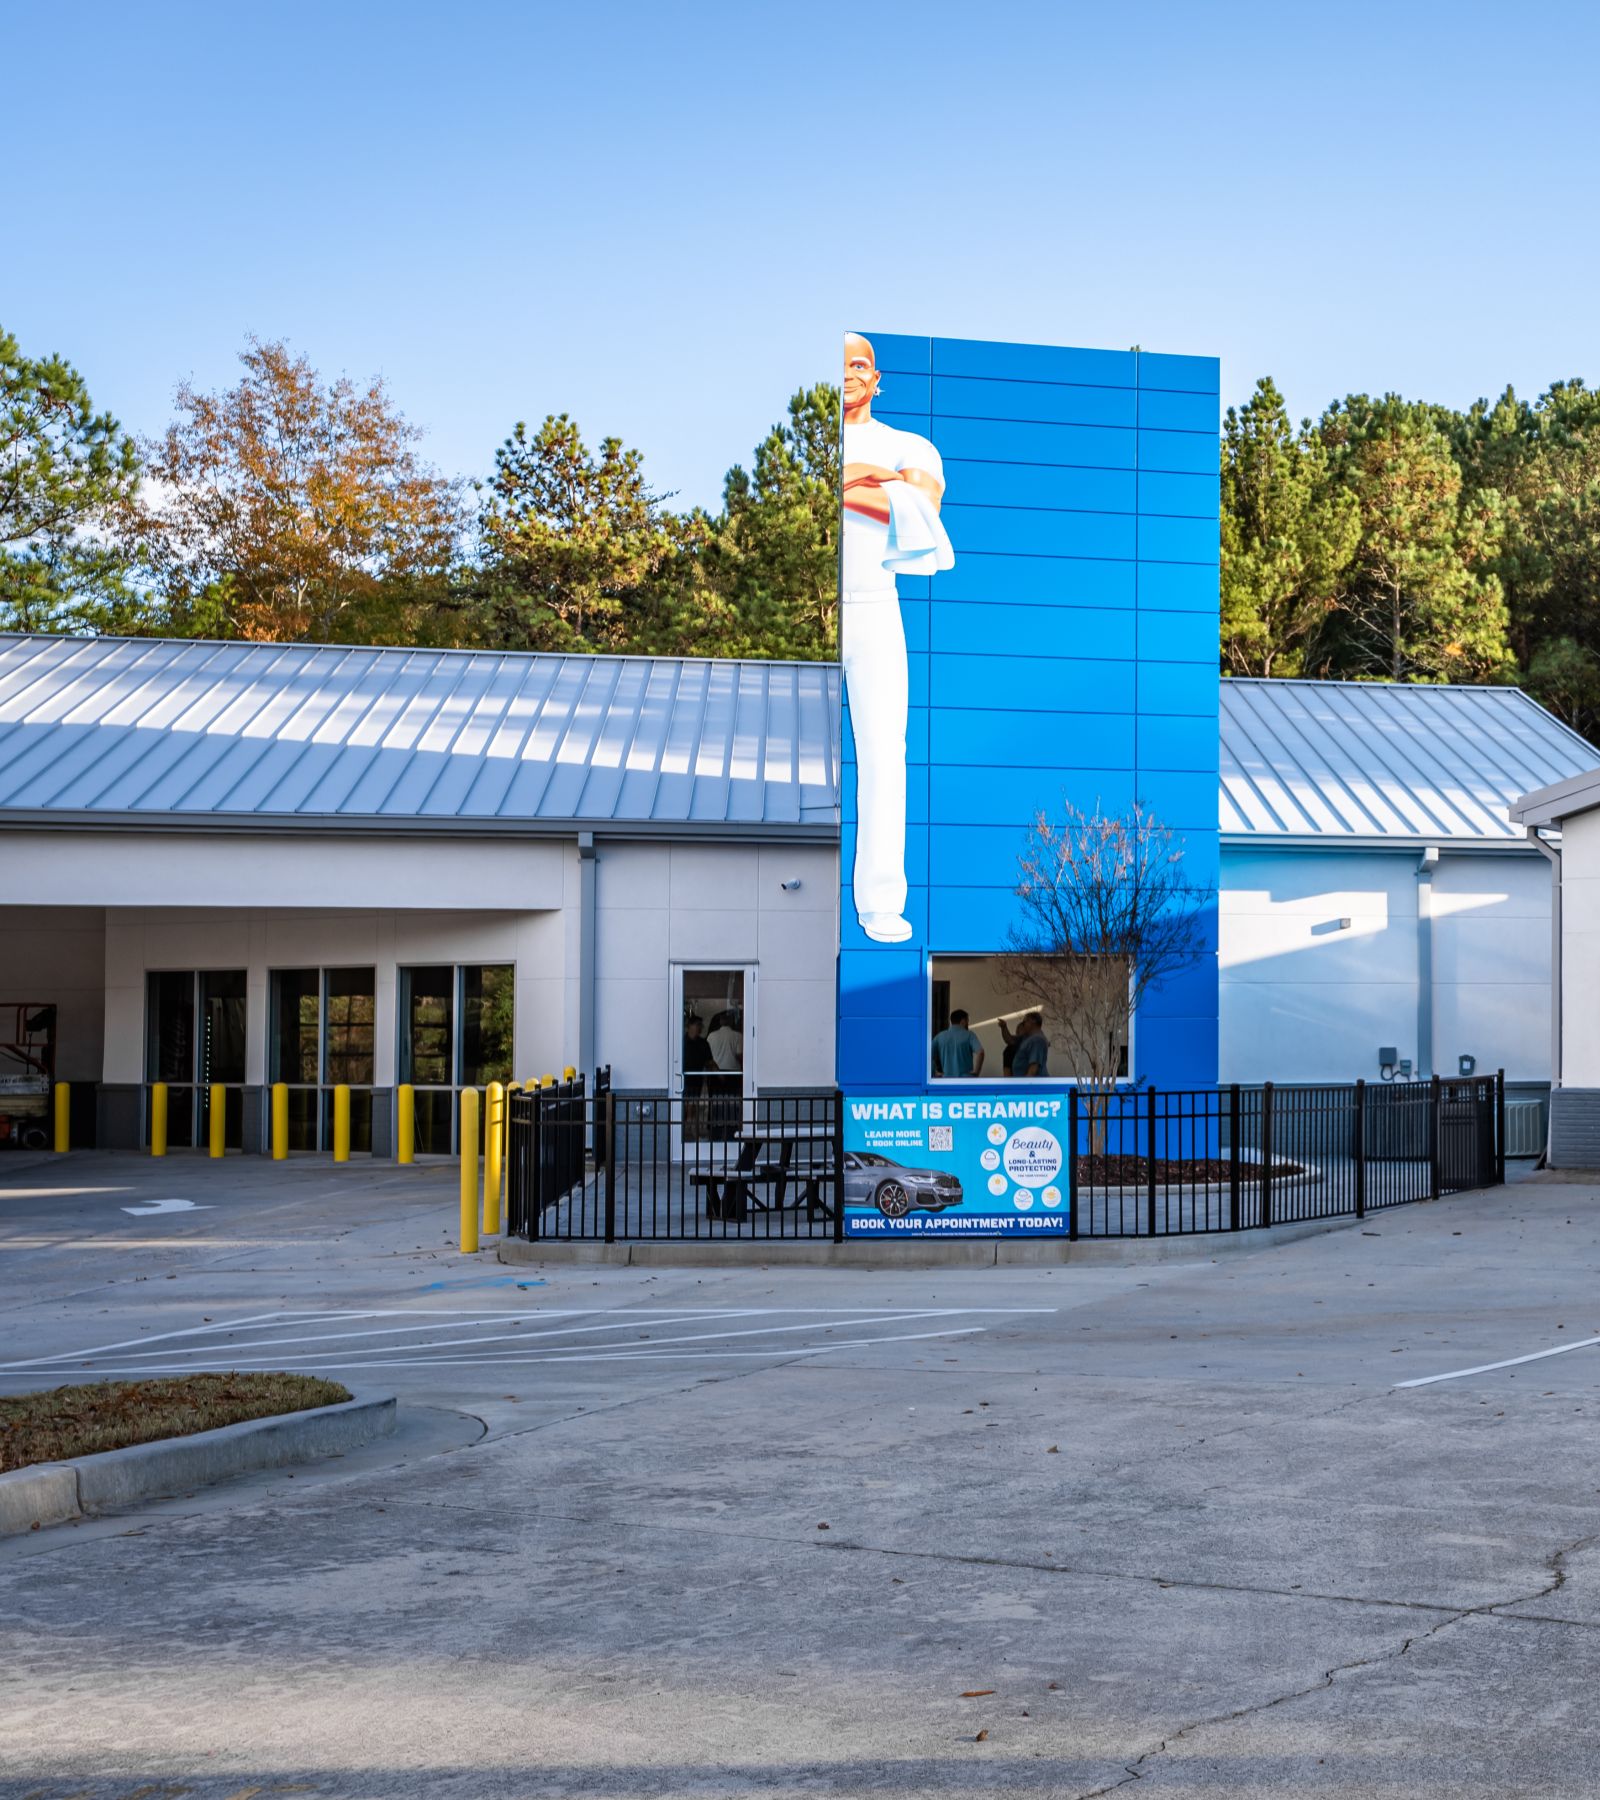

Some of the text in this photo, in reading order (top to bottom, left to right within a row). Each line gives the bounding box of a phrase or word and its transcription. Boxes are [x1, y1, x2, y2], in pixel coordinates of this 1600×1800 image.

[851, 1101, 1061, 1120] WHAT IS CERAMIC?
[864, 1130, 921, 1138] LEARN MORE
[895, 1139, 923, 1147] ONLINE
[1011, 1137, 1053, 1151] Beauty
[851, 1217, 1063, 1229] BOOK YOUR APPOINTMENT TODAY!
